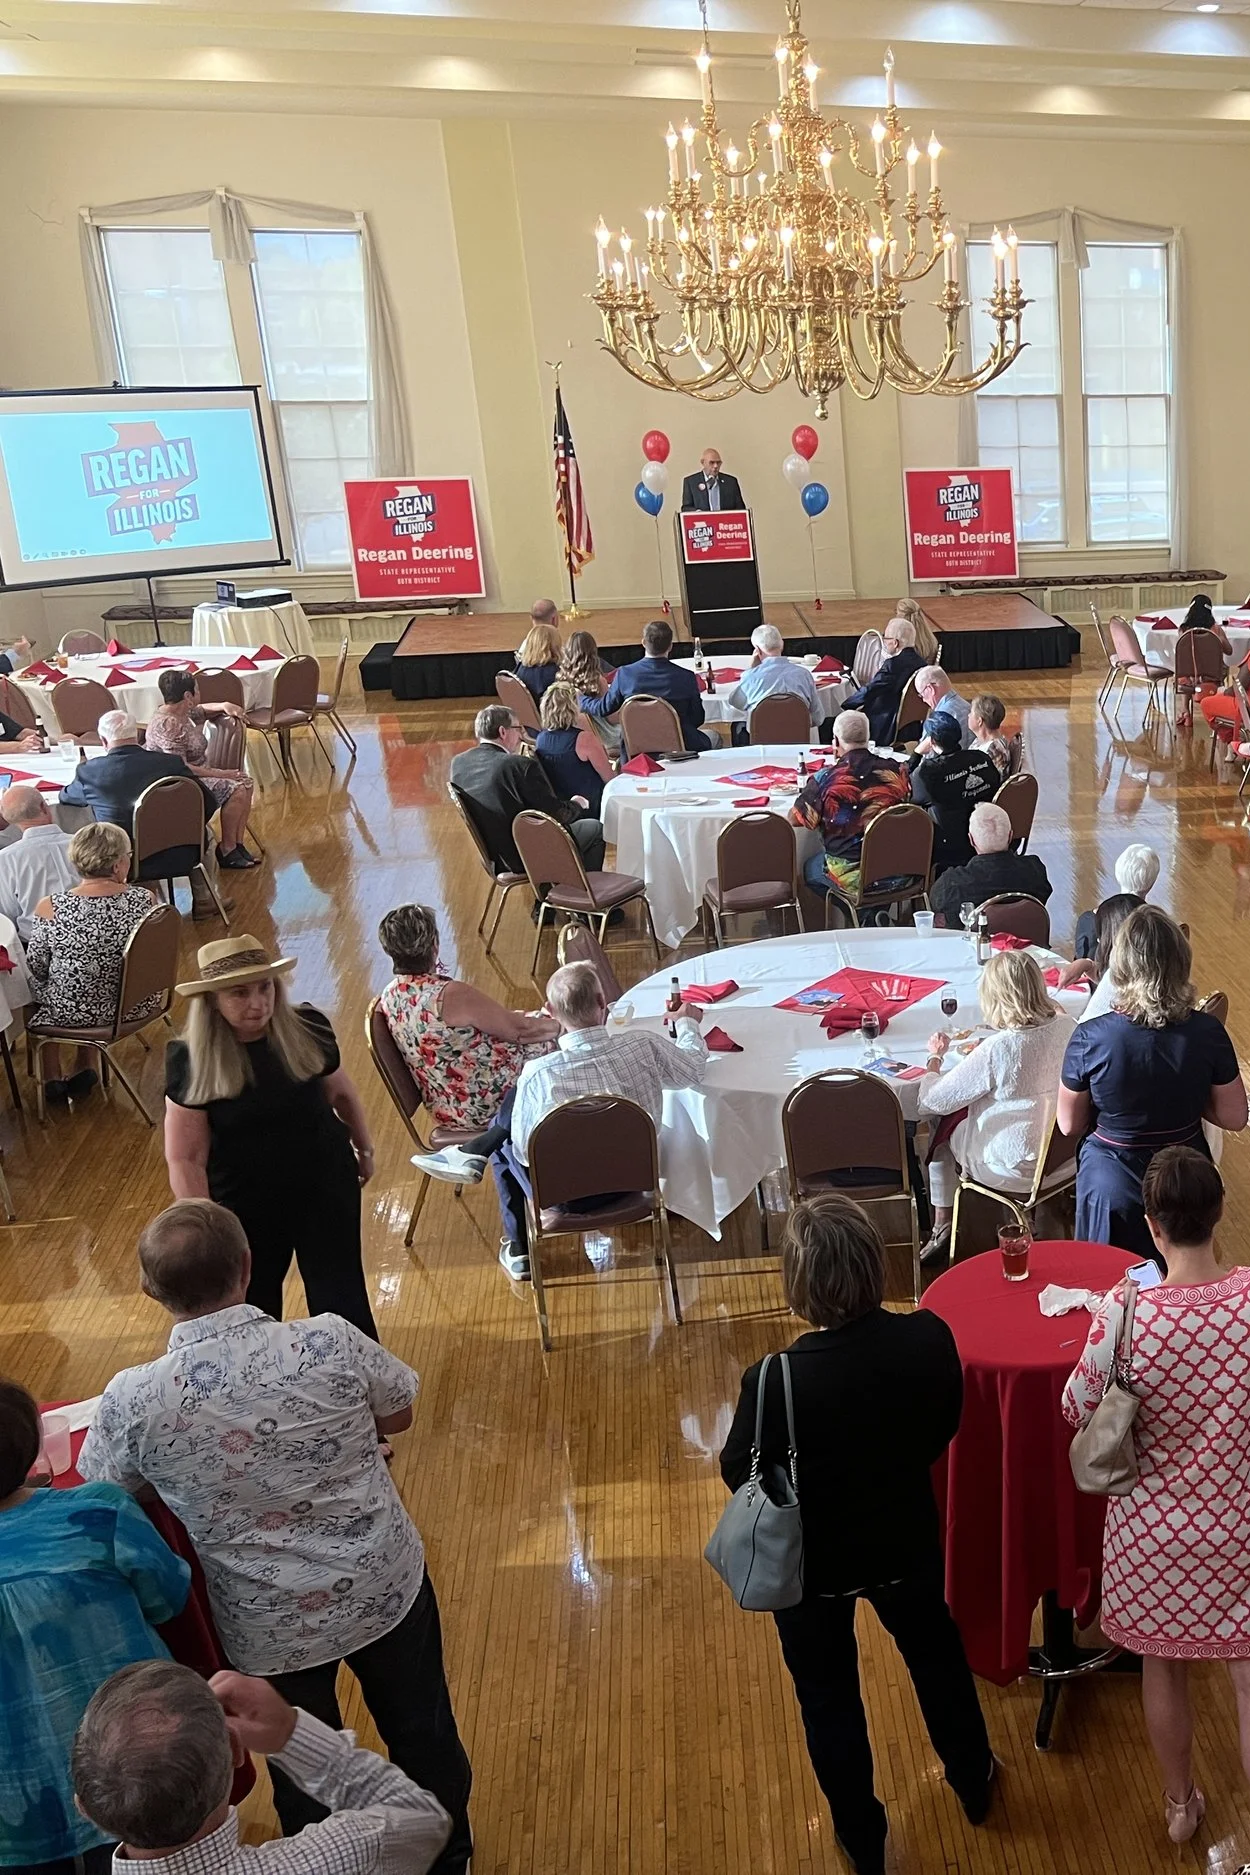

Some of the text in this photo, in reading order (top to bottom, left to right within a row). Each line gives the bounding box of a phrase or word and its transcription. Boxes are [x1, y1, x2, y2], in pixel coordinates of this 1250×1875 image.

[88, 442, 191, 491] REGAN
[139, 488, 160, 500] FOR
[939, 484, 980, 505] REGAN
[384, 495, 433, 518] REGAN
[112, 497, 193, 532] ILLINOIS
[946, 507, 980, 522] ILLINOIS
[394, 520, 433, 536] ILLINOIS
[688, 527, 714, 539] REGAN
[716, 531, 748, 539] Deering
[718, 523, 744, 532] Regan
[913, 530, 1012, 547] Regan Deering
[357, 545, 475, 563] Regan Deering
[379, 566, 456, 576] STATE REPRESENTATIVE
[413, 576, 441, 584] DISTRICT
